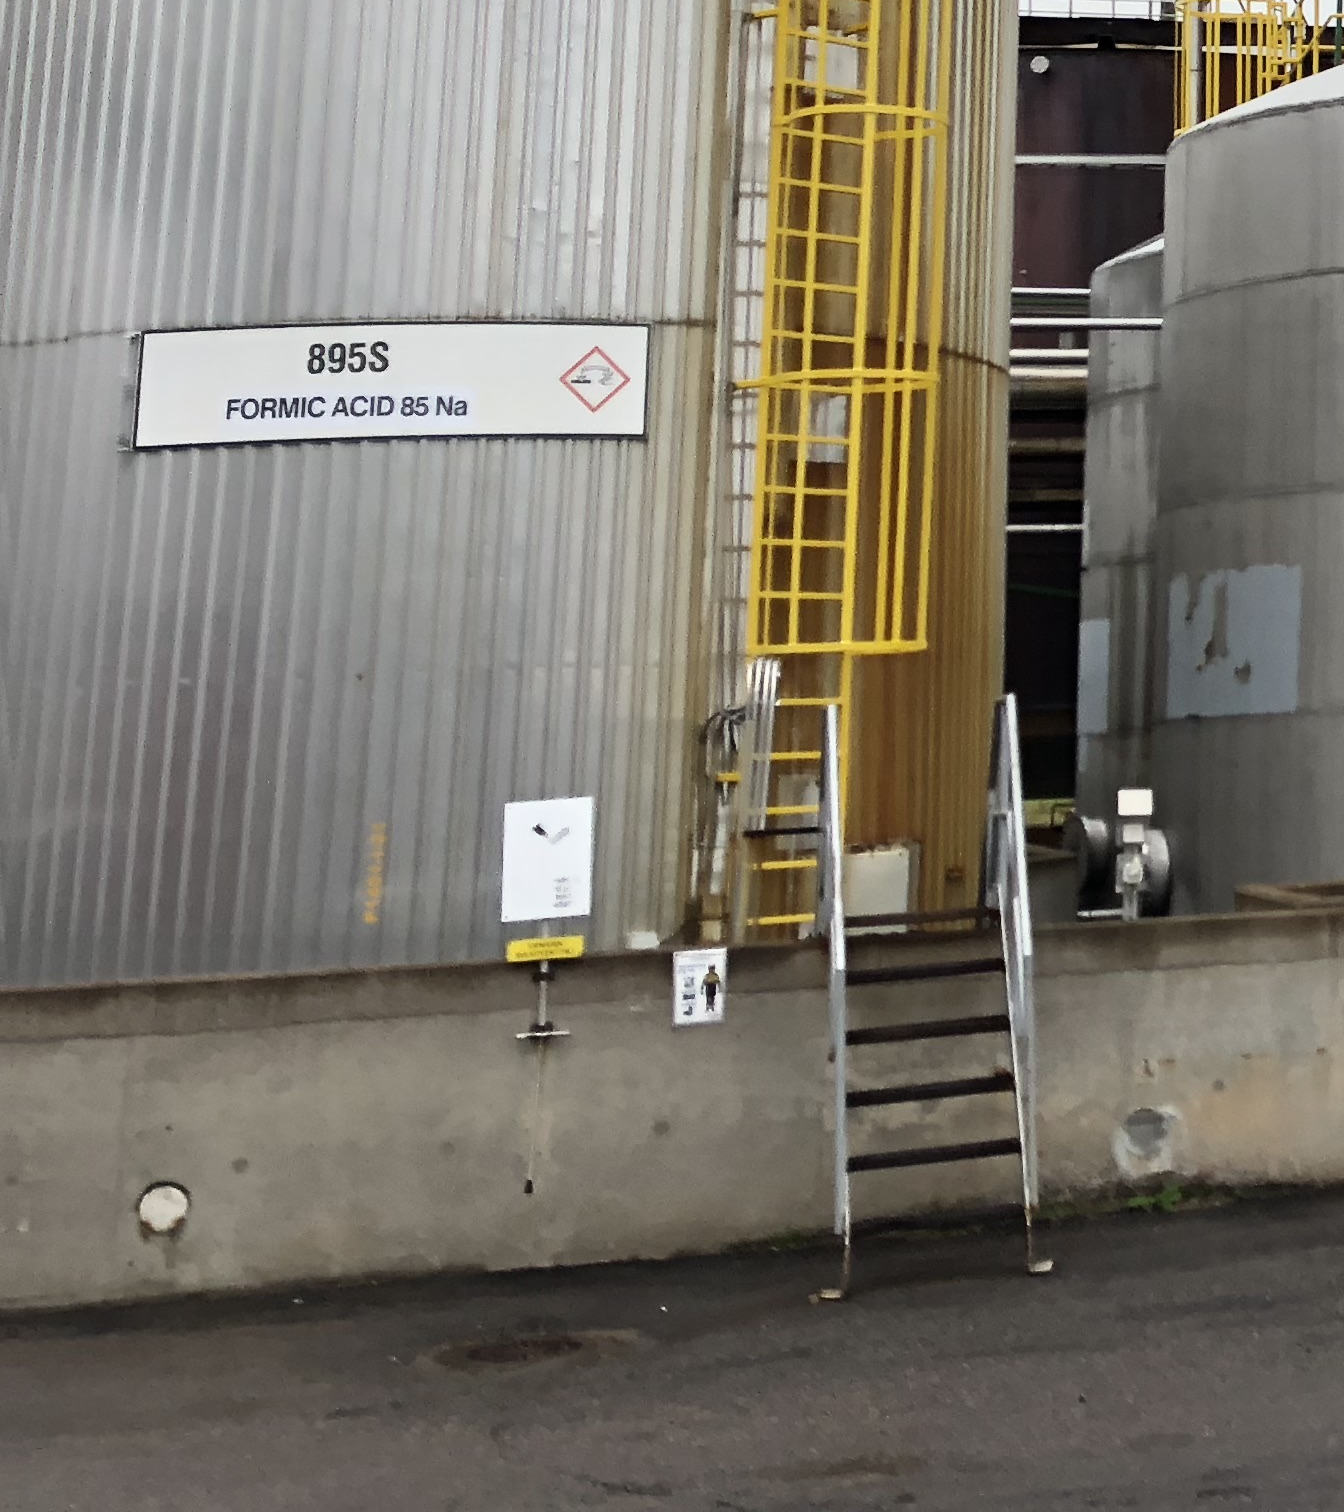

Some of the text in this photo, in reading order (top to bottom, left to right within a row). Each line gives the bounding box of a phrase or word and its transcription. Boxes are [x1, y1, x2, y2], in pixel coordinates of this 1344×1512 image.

[307, 341, 389, 374] 895S
[225, 395, 468, 420] FORMIC ACID 85 Na
